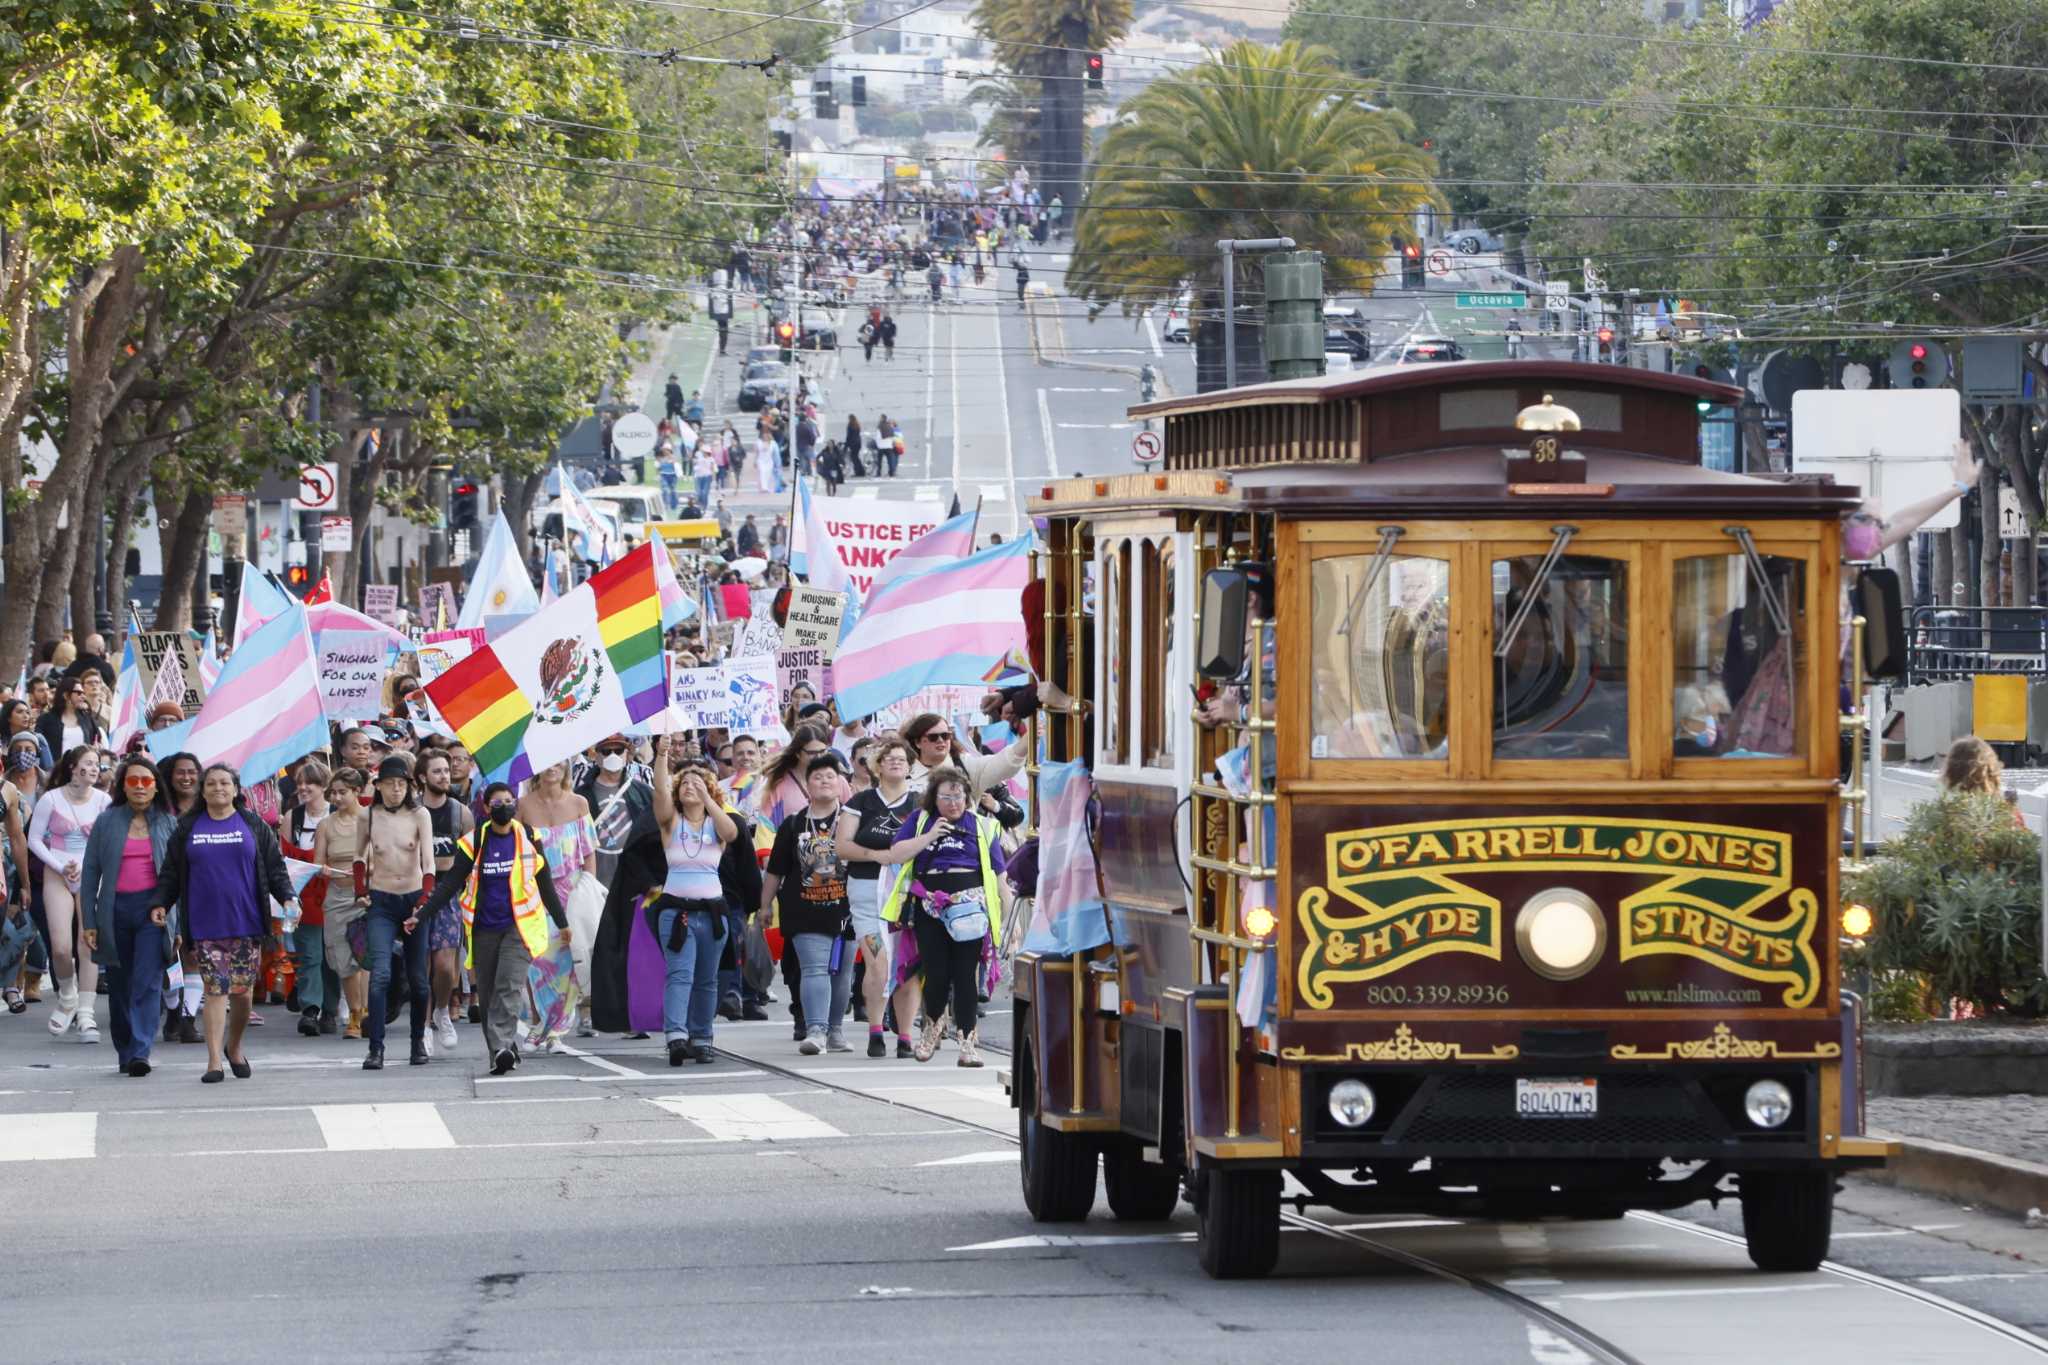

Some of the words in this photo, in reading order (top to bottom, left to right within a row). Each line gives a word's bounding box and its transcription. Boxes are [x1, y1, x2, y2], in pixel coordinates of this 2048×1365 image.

[1469, 295, 1513, 305] Octavia
[1549, 296, 1567, 308] 20
[1536, 439, 1557, 463] 38
[827, 521, 902, 541] USTICE
[801, 592, 837, 606] HOUSING
[814, 605, 820, 614] &
[790, 611, 840, 626] HEALTHCARE
[795, 628, 816, 638] MAKE
[817, 631, 828, 641] US
[139, 633, 184, 653] BLACK
[326, 652, 378, 665] SINGING
[778, 650, 820, 669] JUSTICE
[321, 669, 347, 681] FOR
[351, 671, 377, 681] OUR
[789, 669, 809, 686] FOR
[328, 687, 367, 698] LIVES!
[1624, 829, 1778, 876] JONES
[1633, 905, 1794, 966] STREETS
[1366, 984, 1509, 1004] 800.339.8936
[1625, 983, 1762, 1003] www.nlslimo.com
